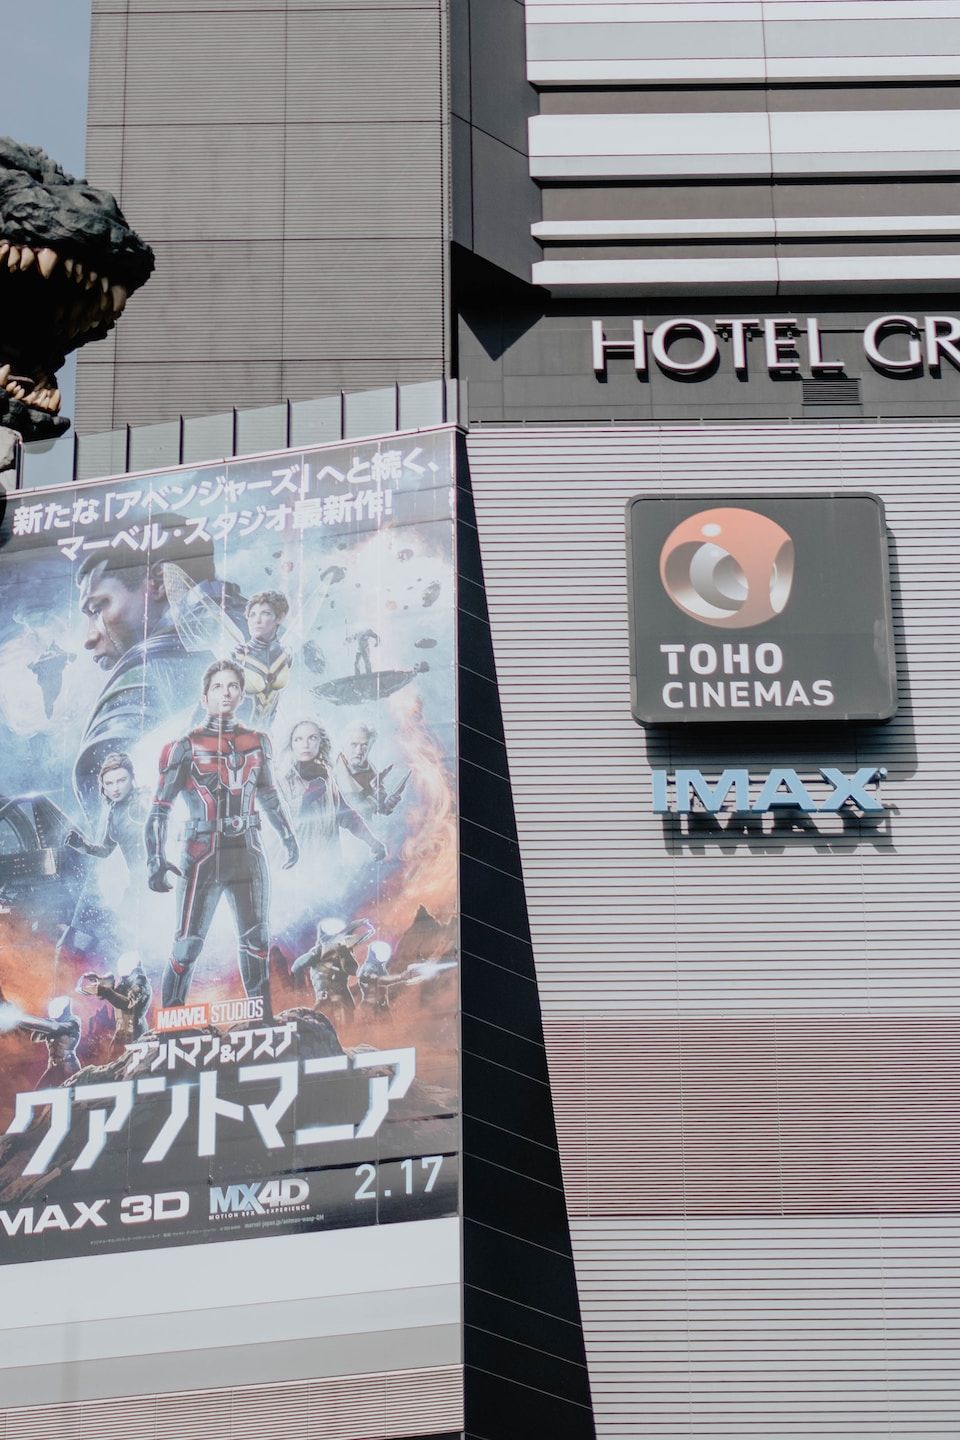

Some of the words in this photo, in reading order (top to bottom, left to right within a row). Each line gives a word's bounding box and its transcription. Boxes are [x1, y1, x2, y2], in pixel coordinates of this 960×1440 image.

[591, 317, 845, 372] HOTEL
[863, 315, 960, 368] GR
[57, 489, 393, 561] マーベル・スタジオ最新作!
[659, 642, 783, 675] TOHO
[661, 679, 835, 709] CINEMAS
[651, 767, 886, 814] IMAX
[156, 1007, 208, 1030] MARVEL
[211, 998, 264, 1023] STUDIOS
[124, 1021, 298, 1073] アントマン&ワスプ
[6, 1047, 416, 1176] クアントマニア
[209, 1178, 310, 1214] MX4D
[355, 1155, 444, 1202] 2.17
[120, 1191, 190, 1225] 3D
[208, 1212, 239, 1221] MOTION
[266, 1204, 310, 1215] EXPERIENCE
